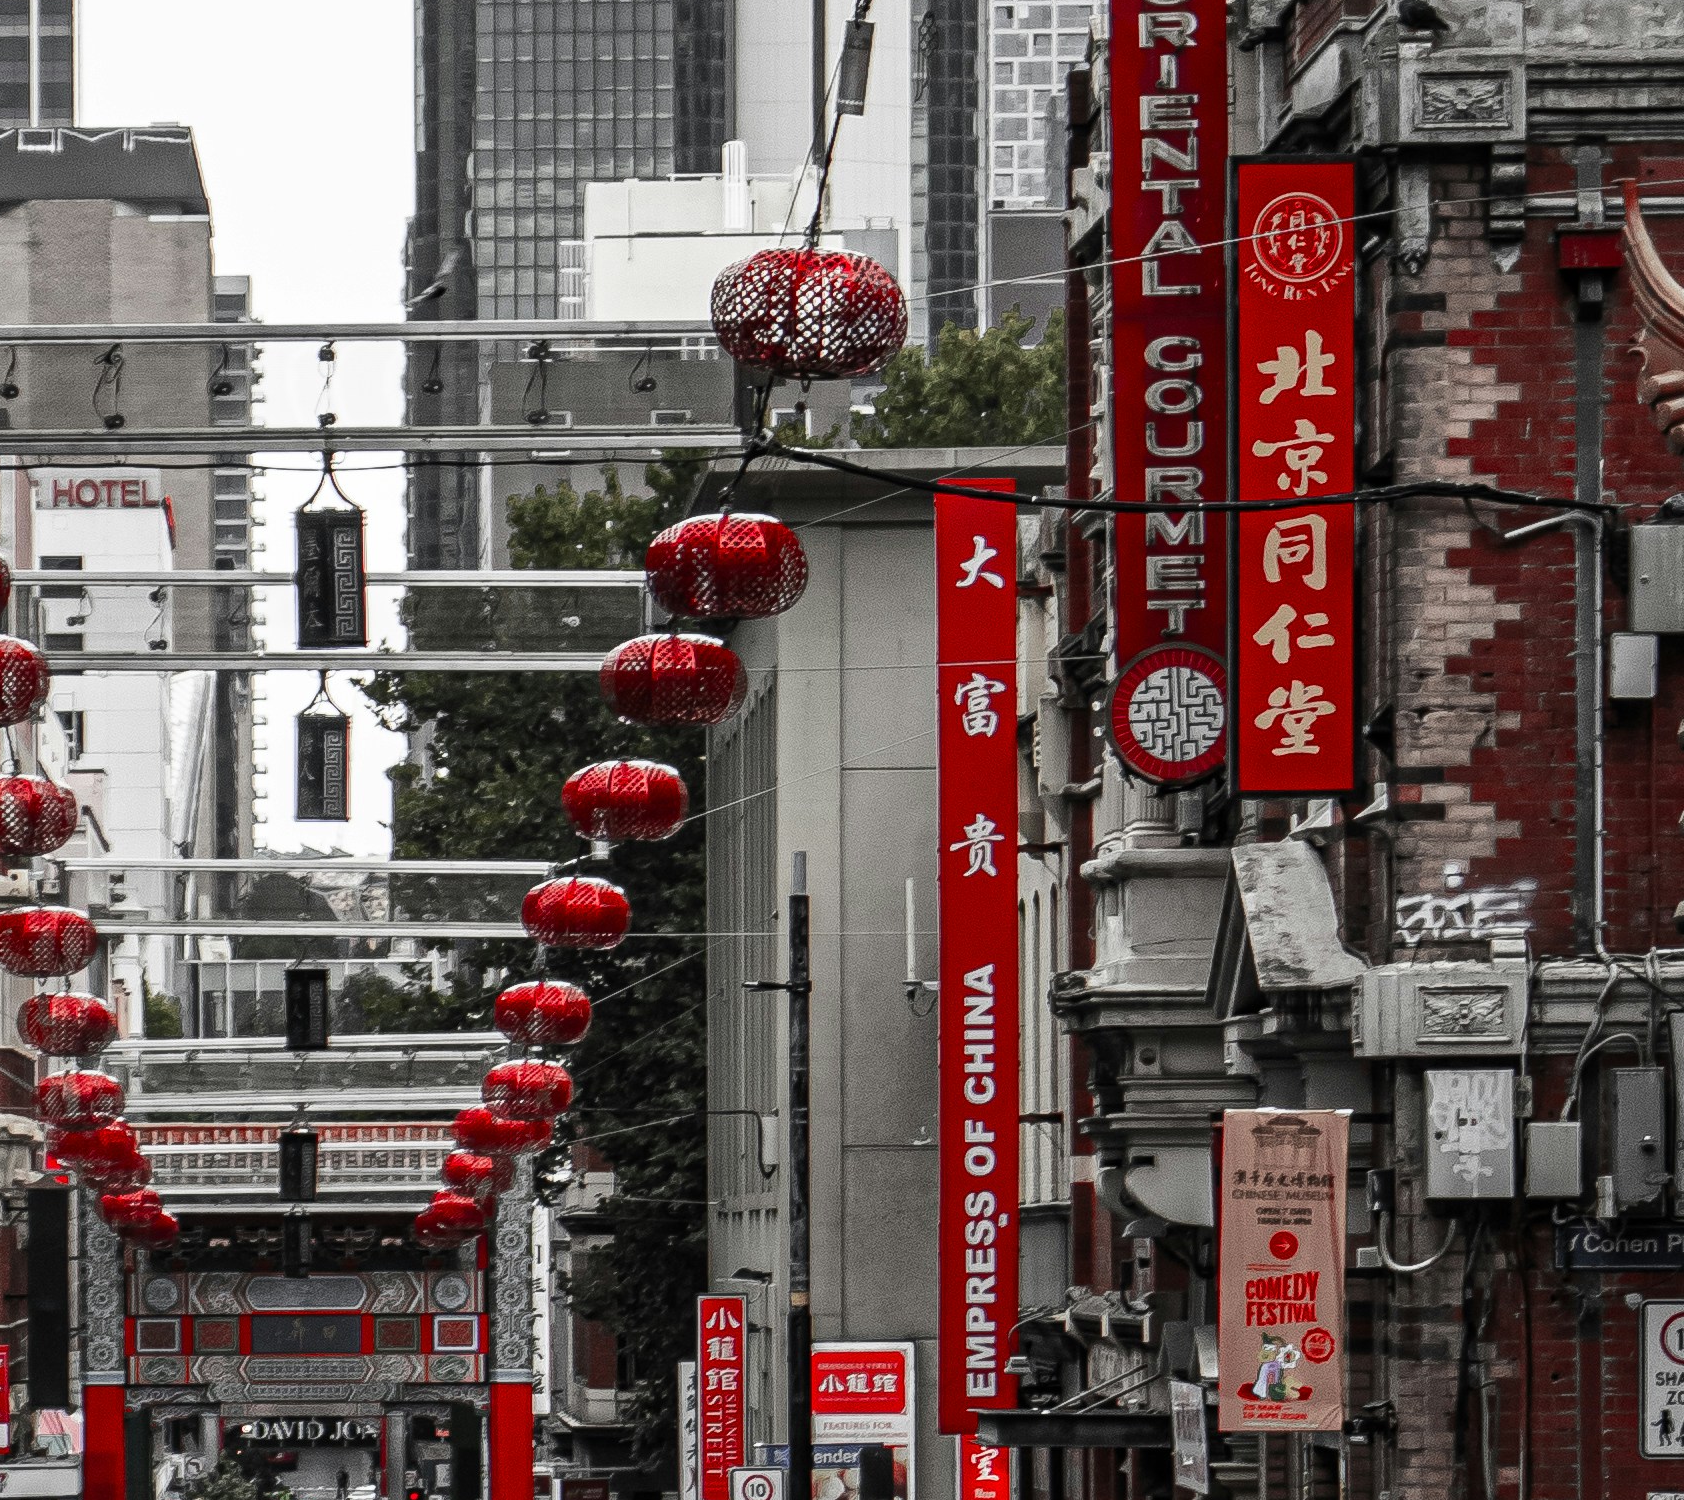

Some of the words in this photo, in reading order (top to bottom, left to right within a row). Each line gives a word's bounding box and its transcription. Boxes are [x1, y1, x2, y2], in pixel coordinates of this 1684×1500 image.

[52, 479, 160, 507] HOTEL
[1143, 334, 1206, 637] GOURMET
[1251, 328, 1337, 757] 北京同仁堂
[962, 962, 998, 1105] CHINA
[963, 1118, 998, 1178] OF
[1232, 1188, 1281, 1201] CHINESE
[1583, 1233, 1658, 1254] Cohen
[964, 1190, 998, 1398] EMPRESS
[1245, 1270, 1320, 1301] COMEDY
[1245, 1301, 1318, 1328] FESTIVAL
[252, 1421, 324, 1440] DAVID
[706, 1395, 724, 1478] STREET
[748, 1482, 767, 1498] 10
